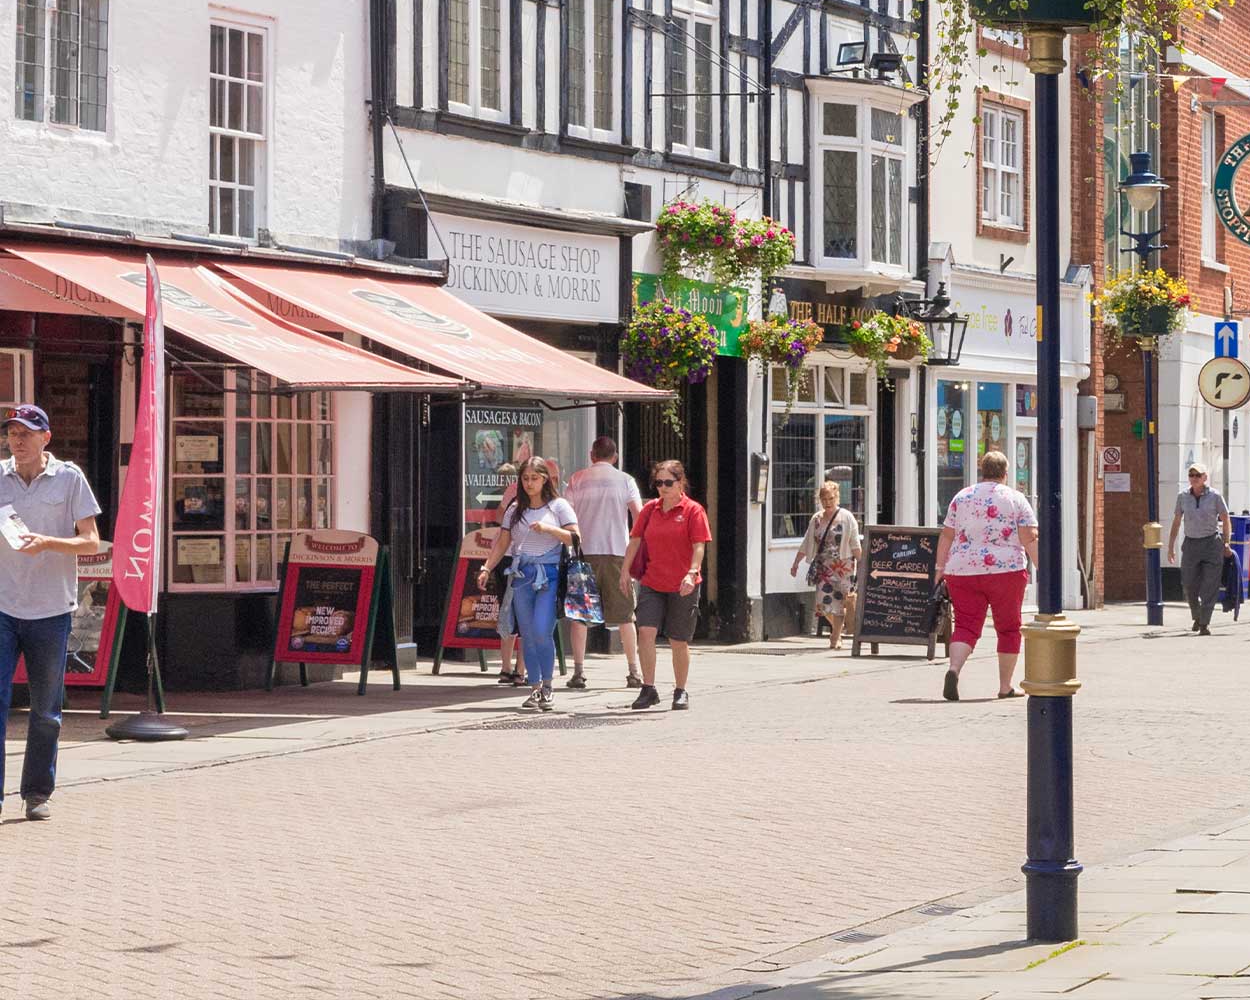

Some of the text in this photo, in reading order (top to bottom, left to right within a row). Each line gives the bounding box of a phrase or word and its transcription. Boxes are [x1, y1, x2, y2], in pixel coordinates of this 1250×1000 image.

[449, 231, 600, 275] THE SAUSAGE SHOP
[446, 263, 600, 303] DICKINSON & MORRIS
[790, 300, 812, 320] THE
[817, 303, 847, 325] HALF
[465, 410, 541, 426] SAUSAGES & BACON
[464, 474, 504, 487] AVAILABLE
[311, 542, 346, 551] WELCOME
[293, 553, 333, 562] DICKINSON
[871, 560, 929, 573] BEER GARDEN
[305, 581, 354, 592] THE PERFECT
[480, 595, 498, 603] NEW
[315, 607, 335, 615] NEW
[471, 603, 500, 612] IMPROV
[305, 616, 345, 626] IMPROVED
[310, 626, 338, 635] RECIPE
